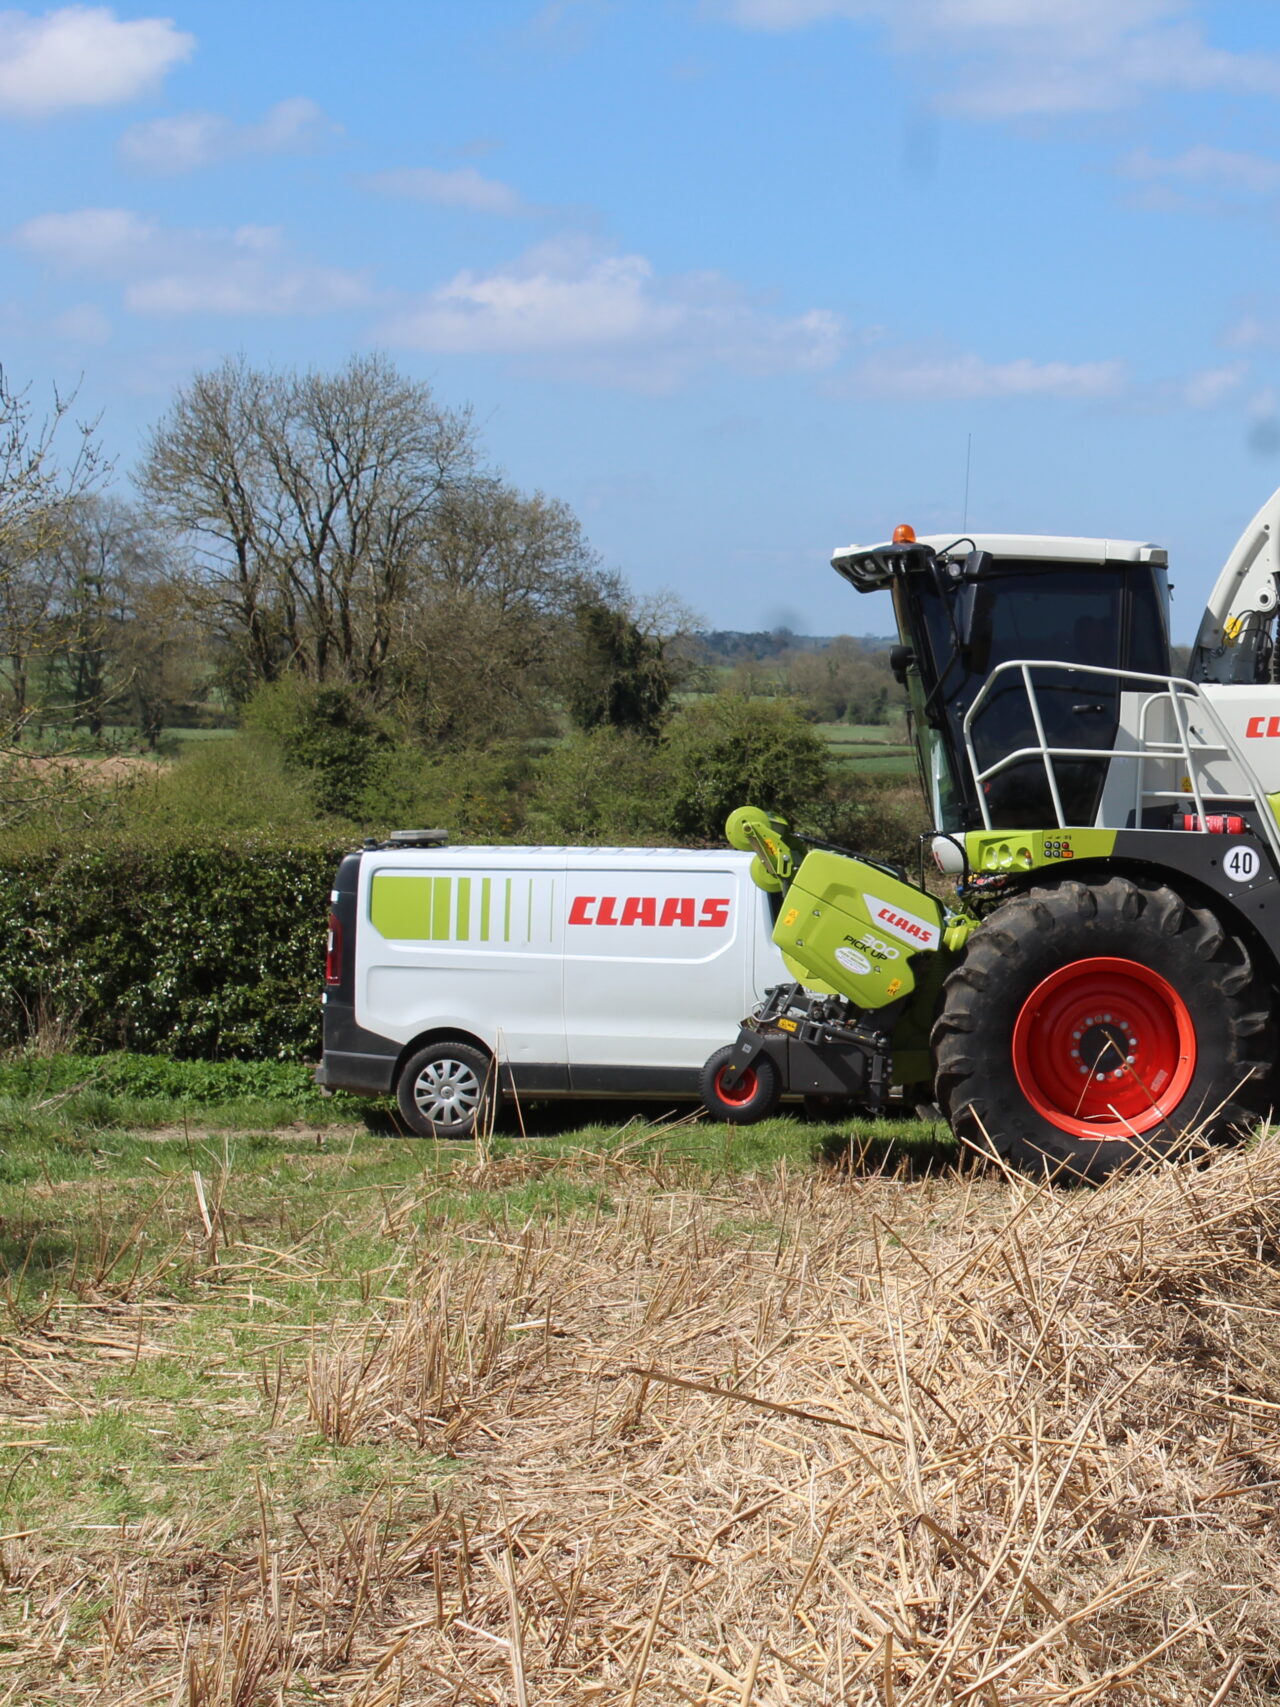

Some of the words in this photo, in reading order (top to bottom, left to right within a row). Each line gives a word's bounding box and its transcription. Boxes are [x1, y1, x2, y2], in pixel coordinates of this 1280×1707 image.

[1229, 851, 1253, 875] 40
[567, 896, 731, 928] CLAAS
[877, 908, 933, 942] CLAAS
[843, 935, 871, 953] PICK
[870, 949, 888, 960] UP
[860, 933, 900, 960] 300
